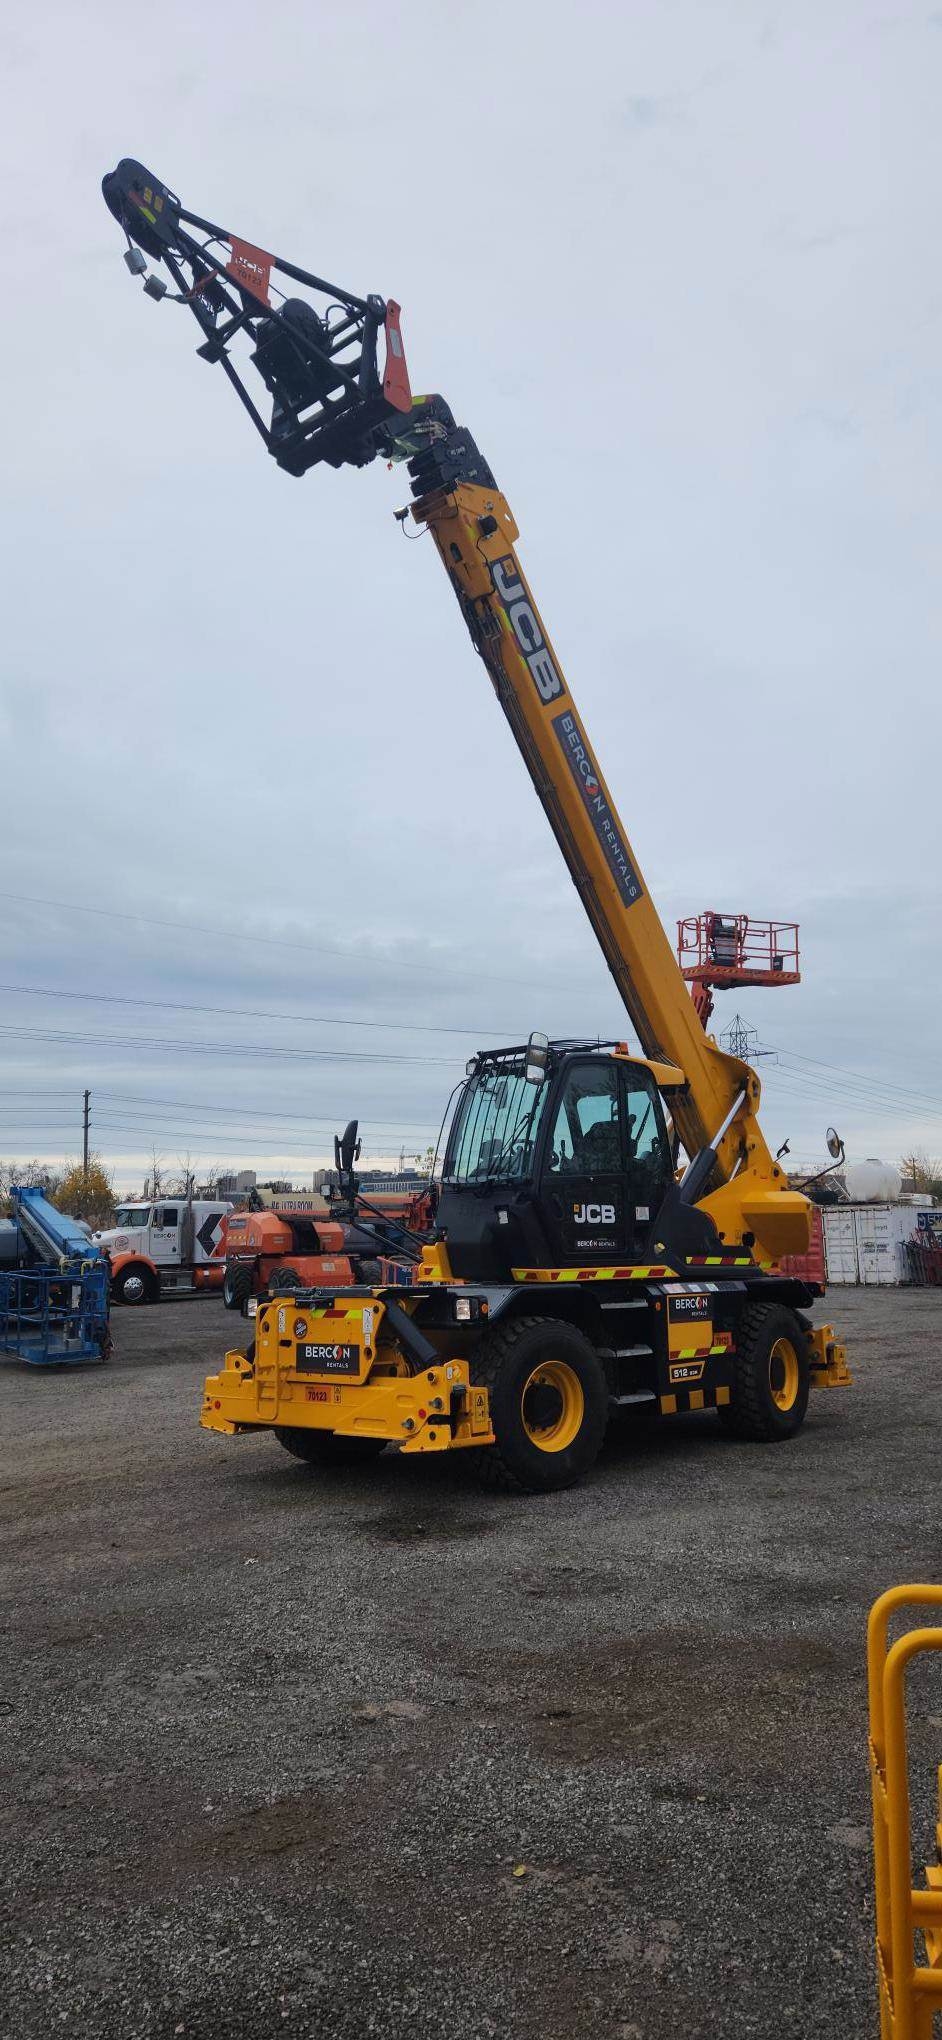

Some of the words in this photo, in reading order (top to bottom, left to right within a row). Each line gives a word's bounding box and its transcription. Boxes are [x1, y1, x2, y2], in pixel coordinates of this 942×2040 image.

[493, 563, 561, 699] JCB
[561, 715, 605, 813] BERCON
[602, 820, 637, 898] RENTALS
[574, 1204, 616, 1223] JCB
[675, 1297, 708, 1311] BERCON
[305, 1345, 350, 1360] BERCON
[674, 1368, 689, 1378] 512
[307, 1391, 328, 1402] 70123
